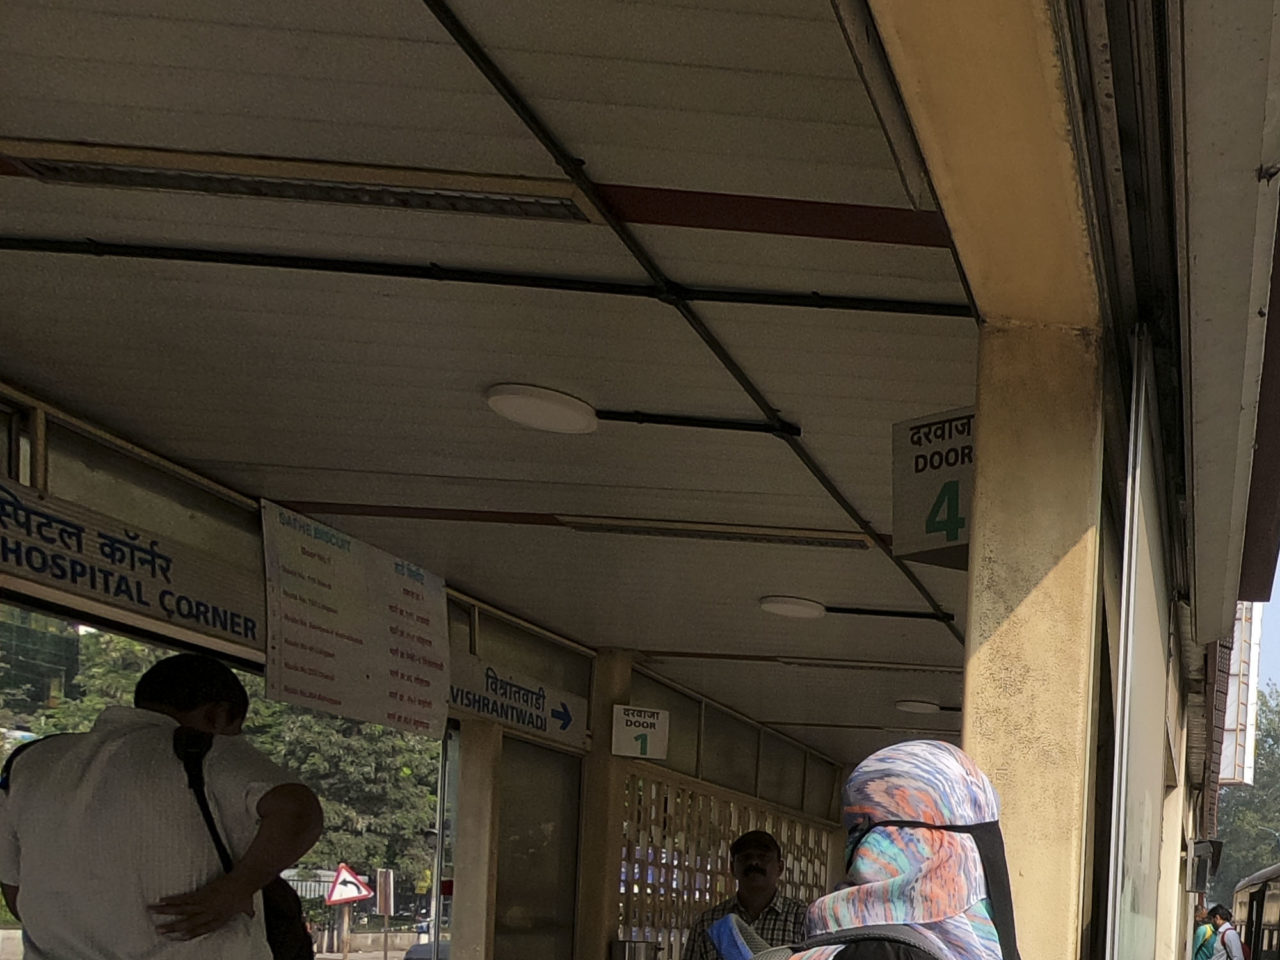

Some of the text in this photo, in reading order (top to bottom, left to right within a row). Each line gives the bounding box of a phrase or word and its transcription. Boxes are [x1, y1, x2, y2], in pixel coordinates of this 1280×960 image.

[909, 413, 976, 447] दरवाज
[914, 444, 974, 474] DOOR
[925, 479, 966, 542] 4
[97, 528, 174, 584] कॉर्नर
[0, 535, 152, 607] HOSPITAL
[158, 589, 258, 641] CORNER
[450, 684, 548, 733] VISHRANTWADI
[622, 707, 661, 722] दरवाजा
[624, 718, 657, 731] DOOR
[633, 732, 649, 756] 1
